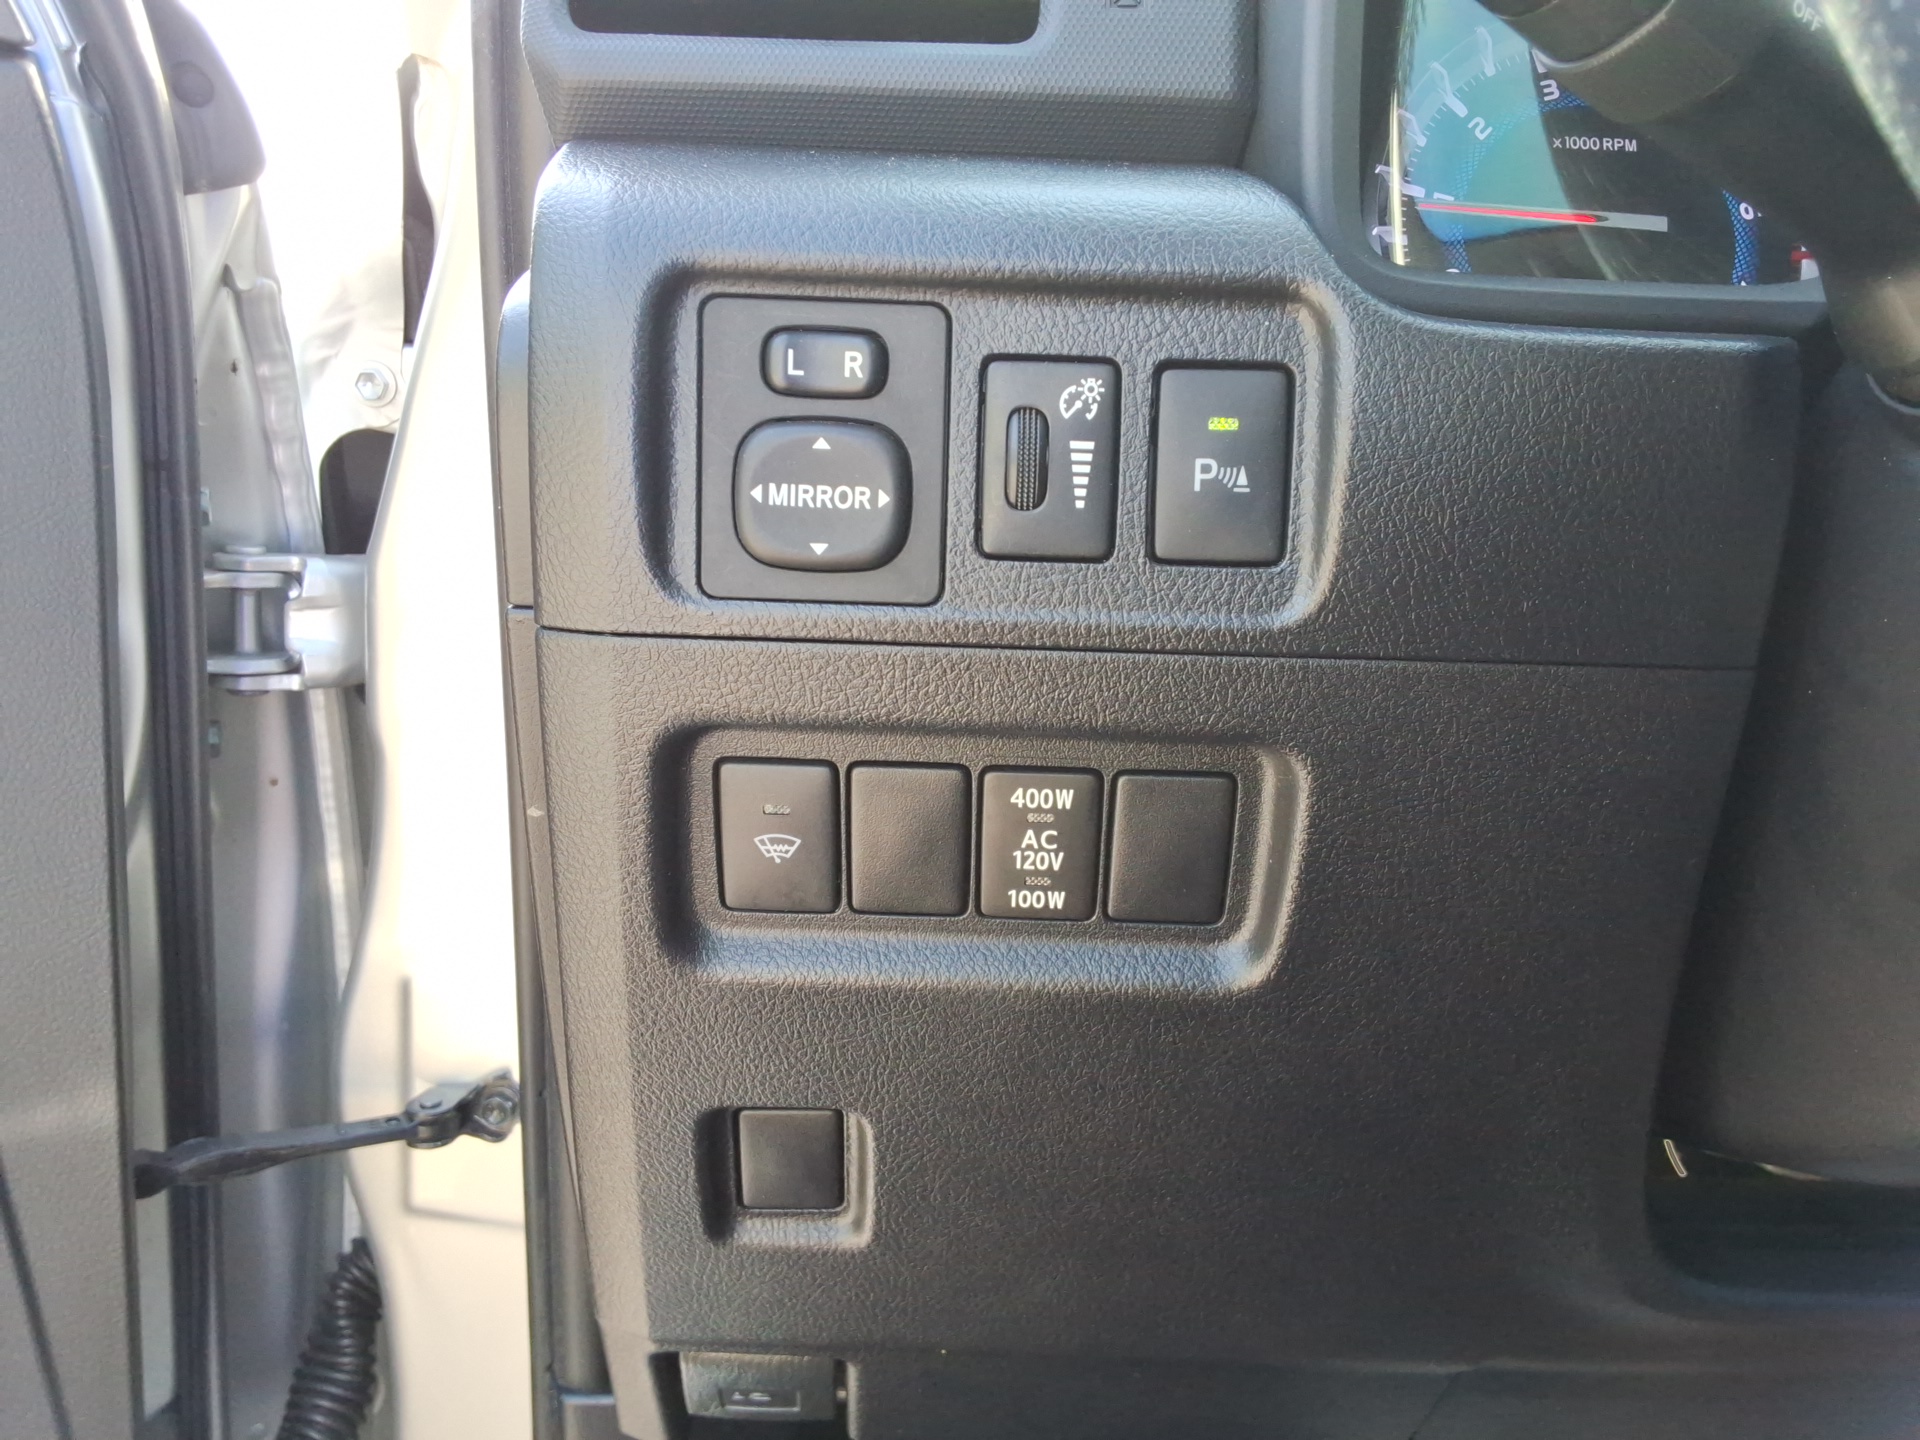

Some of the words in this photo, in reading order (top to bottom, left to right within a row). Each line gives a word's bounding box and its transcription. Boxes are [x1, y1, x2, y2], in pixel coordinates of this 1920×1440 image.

[1793, 0, 1824, 31] OFF
[1540, 79, 1560, 101] 3
[1467, 116, 1493, 140] 2
[1602, 137, 1637, 152] RPM
[787, 348, 805, 376] L
[844, 350, 864, 378] R
[1193, 457, 1219, 492] P
[768, 482, 872, 510] MIRROR
[1010, 787, 1074, 809] 400W
[1020, 829, 1058, 849] AC
[1012, 850, 1064, 871] 120V
[1007, 889, 1066, 910] 100W
